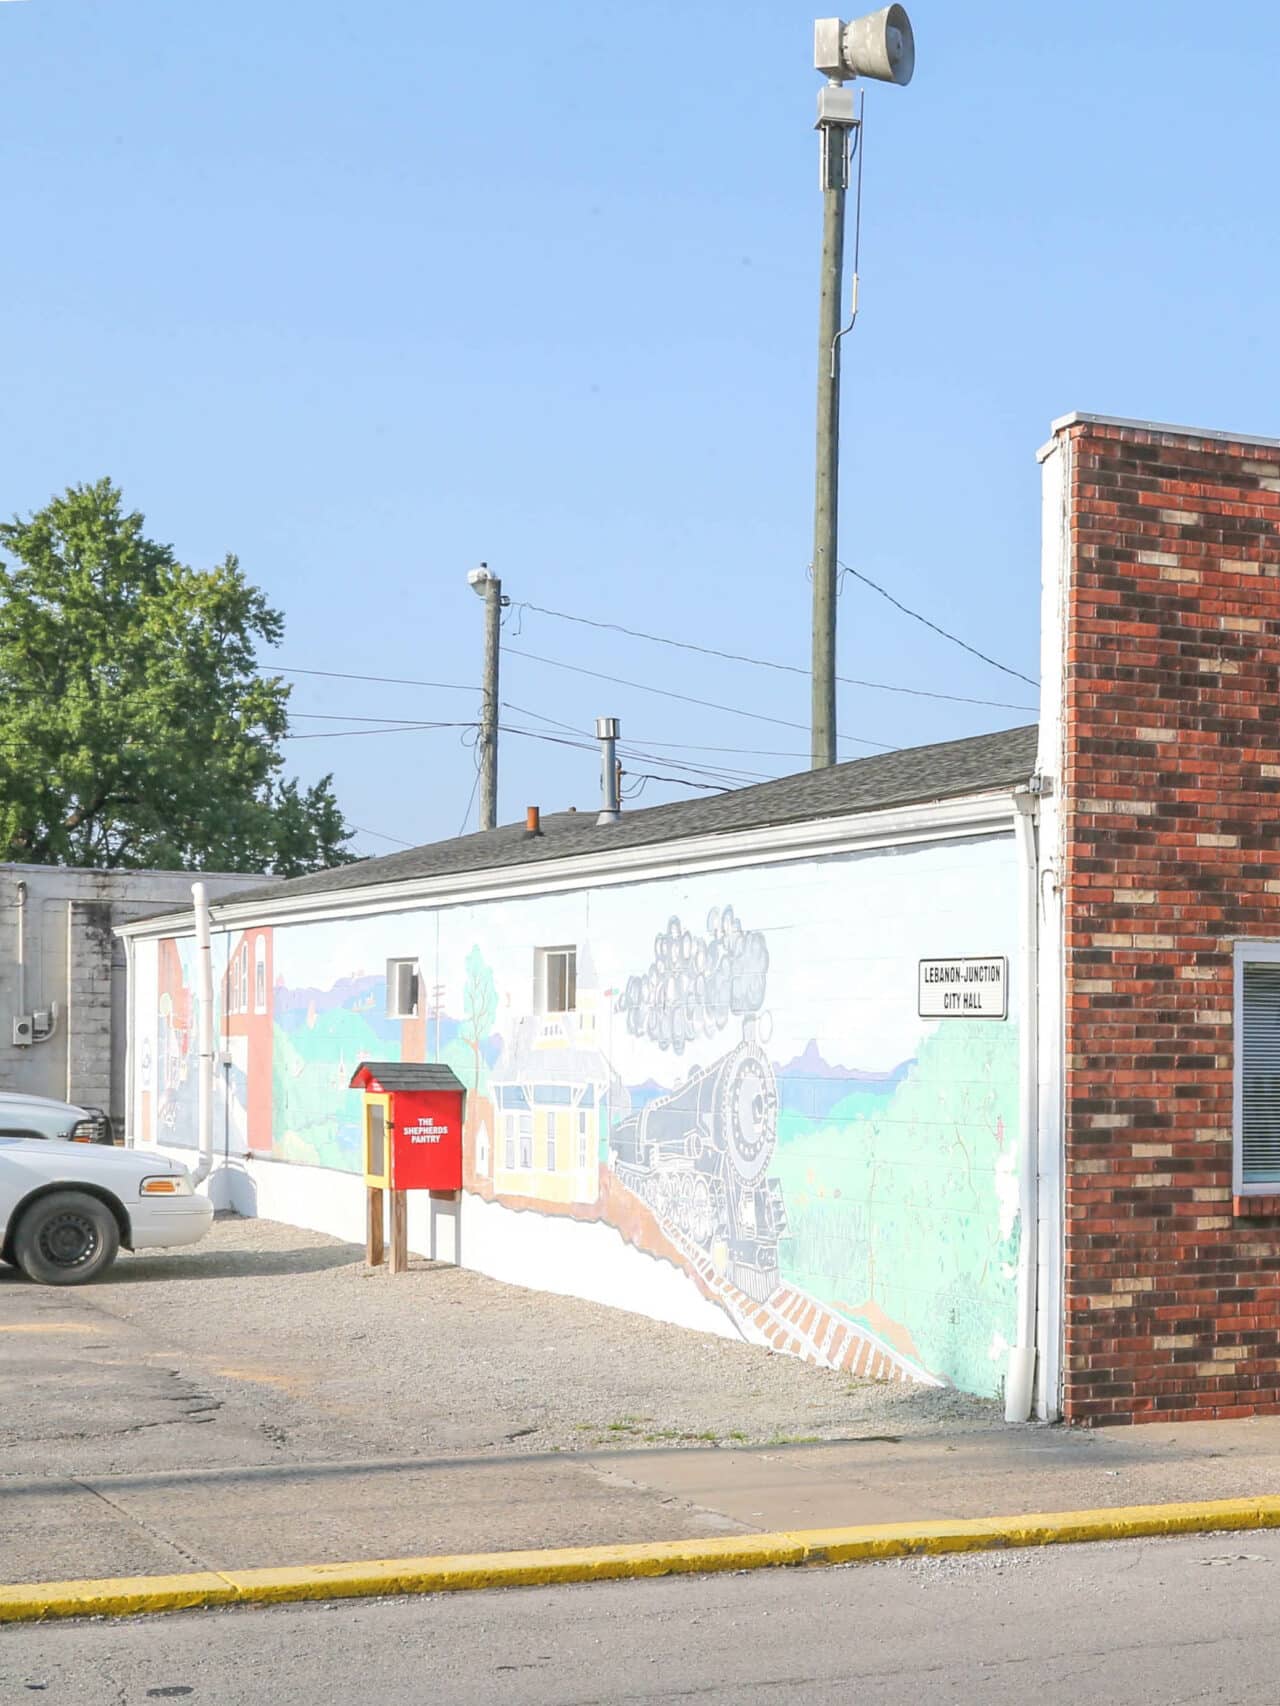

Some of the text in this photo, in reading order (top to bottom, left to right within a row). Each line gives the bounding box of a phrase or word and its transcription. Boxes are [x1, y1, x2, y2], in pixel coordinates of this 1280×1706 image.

[925, 965, 1000, 983] LEBANON-JUNCTION
[943, 992, 982, 1009] CITY HALL
[418, 1118, 433, 1126] THE
[403, 1126, 448, 1135] SHEPHERDS
[411, 1135, 441, 1144] PANTRY
